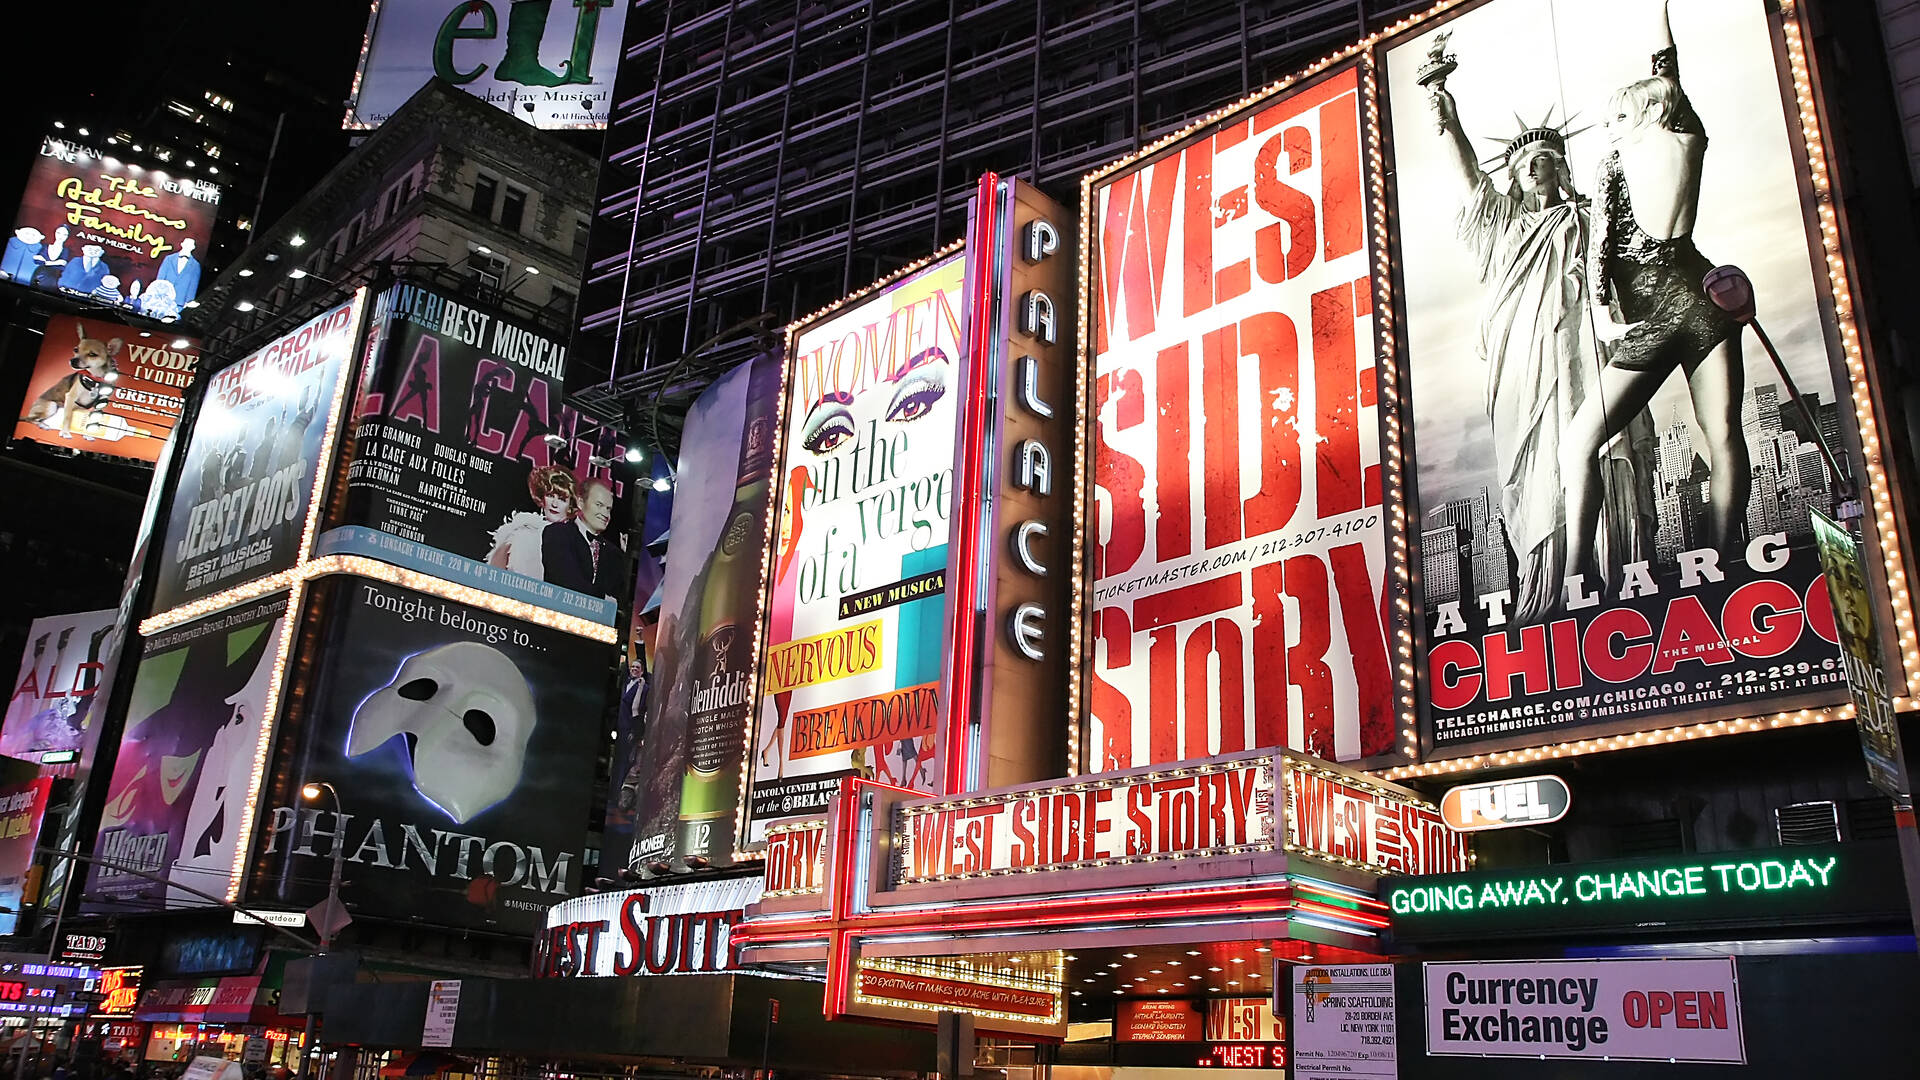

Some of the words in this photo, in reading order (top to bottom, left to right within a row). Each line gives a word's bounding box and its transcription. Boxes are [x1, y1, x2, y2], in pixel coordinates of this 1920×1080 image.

[463, 87, 536, 104] oadway
[543, 90, 608, 102] Musical
[40, 145, 78, 164] LANE
[43, 134, 104, 161] NATHAN
[56, 177, 187, 230] Addams
[100, 174, 159, 198] The
[65, 201, 173, 259] Family
[1096, 66, 1364, 357] WEST
[76, 231, 87, 239] A
[86, 234, 107, 244] NEW
[106, 239, 144, 255] MUSICAL
[263, 305, 351, 366] CROWD
[374, 284, 444, 325] WINNER!
[440, 299, 490, 349] BEST
[491, 320, 566, 382] MUSICAL
[407, 314, 439, 331] AWARD
[798, 276, 966, 414] WOMEN
[351, 328, 441, 435] LA
[382, 425, 422, 450] GRAMMER
[434, 442, 467, 466] DOUGLAS
[469, 455, 494, 475] HODGE
[1010, 216, 1060, 663] PALACE
[1094, 275, 1384, 580] SIDE
[366, 441, 378, 457] LA
[381, 447, 407, 466] CAGE
[408, 453, 428, 473] AUX
[431, 460, 466, 486] FOLLES
[366, 465, 401, 486] HERMAN
[801, 453, 841, 513] on
[850, 418, 909, 494] the
[418, 481, 448, 501] HARVEY
[449, 490, 487, 515] FIERSTEIN
[442, 482, 458, 491] BOOK
[176, 483, 255, 565] JERSEY
[248, 459, 307, 537] BOYS
[409, 512, 423, 522] PAGE
[856, 467, 954, 552] verge
[188, 556, 219, 578] BEST
[220, 541, 273, 568] MUSICAL
[800, 524, 839, 606] of
[839, 541, 860, 595] a
[1096, 549, 1247, 603] TICKETMASTER.COM
[1261, 514, 1379, 557] 212-307-4100
[501, 574, 554, 599] TELECHARGE.COM
[839, 602, 850, 618] A
[852, 594, 884, 613] NEW
[363, 585, 436, 623] Tonight
[440, 604, 508, 645] belongs
[1433, 589, 1512, 638] AT
[767, 624, 878, 692] NERVOUS
[1090, 542, 1396, 777] STORY
[1662, 646, 1689, 658] THE
[1694, 634, 1761, 652] MUSICAL
[695, 713, 718, 725] SINGLE
[720, 709, 740, 720] MALT
[792, 685, 939, 754] BREAKDOWN
[1435, 680, 1687, 730] TELECHARGE.COM/CHICAGO
[1694, 679, 1712, 690] or
[1436, 712, 1575, 741] CHICAGOTHEMUSICAL.COM
[1591, 697, 1669, 719] AMBASSADOR
[1671, 688, 1725, 708] THEATRE
[1736, 683, 1767, 697] 49TH
[1770, 679, 1791, 692] ST.
[1795, 678, 1808, 688] AT
[753, 785, 786, 800] LINCOLN
[785, 780, 818, 795] CENTER
[756, 804, 765, 814] at
[765, 800, 780, 812] the
[1459, 780, 1550, 825] FUEL
[693, 824, 711, 850] 12
[911, 803, 1005, 876] WEST
[1010, 786, 1113, 868] SIDE
[1126, 767, 1258, 856] STORY
[1292, 768, 1375, 871] WEST
[97, 829, 169, 877] WICKED
[264, 805, 575, 897] PHANTOM
[511, 898, 544, 912] MAJESTIC
[1391, 885, 1474, 914] GOING
[1575, 866, 1707, 901] CHANGE
[1711, 856, 1836, 893] TODAY
[263, 914, 297, 923] outdoor
[878, 976, 914, 991] EXCITING
[915, 980, 924, 993] IT
[925, 984, 953, 996] MAKES
[953, 986, 971, 998] YOU
[971, 989, 990, 1000] ACHE
[991, 991, 1010, 1003] WITH
[1322, 996, 1346, 1009] SPRING
[1347, 996, 1394, 1008] SCAFFOLDING
[1446, 971, 1598, 1013] Currency
[1622, 990, 1729, 1030] OPEN
[265, 1029, 288, 1042] Pizza
[1206, 998, 1267, 1041] WEST
[1350, 1023, 1364, 1033] NEW
[1361, 1011, 1382, 1021] BORDEN
[1382, 1011, 1394, 1021] AVE
[1442, 1008, 1609, 1052] Exchange
[1295, 1050, 1314, 1058] Permit
[1295, 1063, 1321, 1071] Electrical
[1321, 1064, 1341, 1072] Permit
